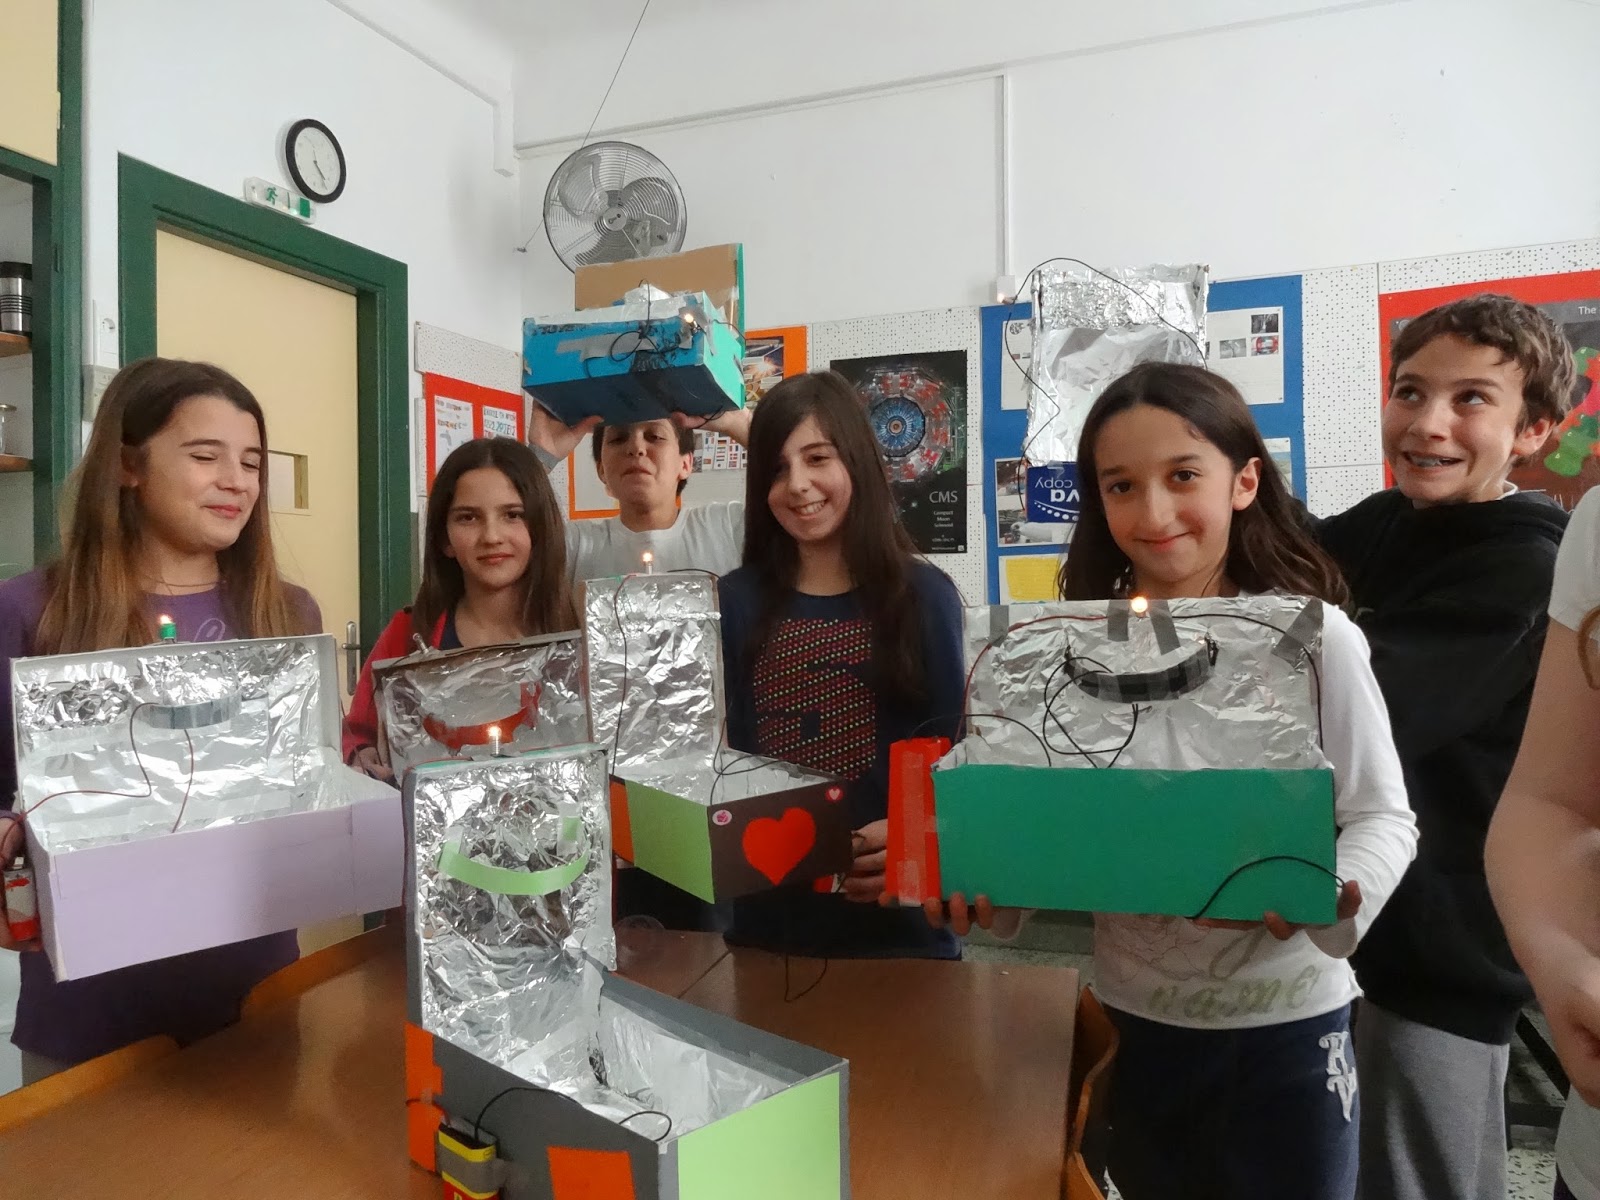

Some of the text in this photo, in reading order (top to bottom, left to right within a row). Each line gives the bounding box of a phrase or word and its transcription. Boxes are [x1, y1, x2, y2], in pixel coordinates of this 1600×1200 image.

[1578, 305, 1597, 315] The
[1034, 476, 1073, 489] copy
[929, 490, 958, 503] CMS
